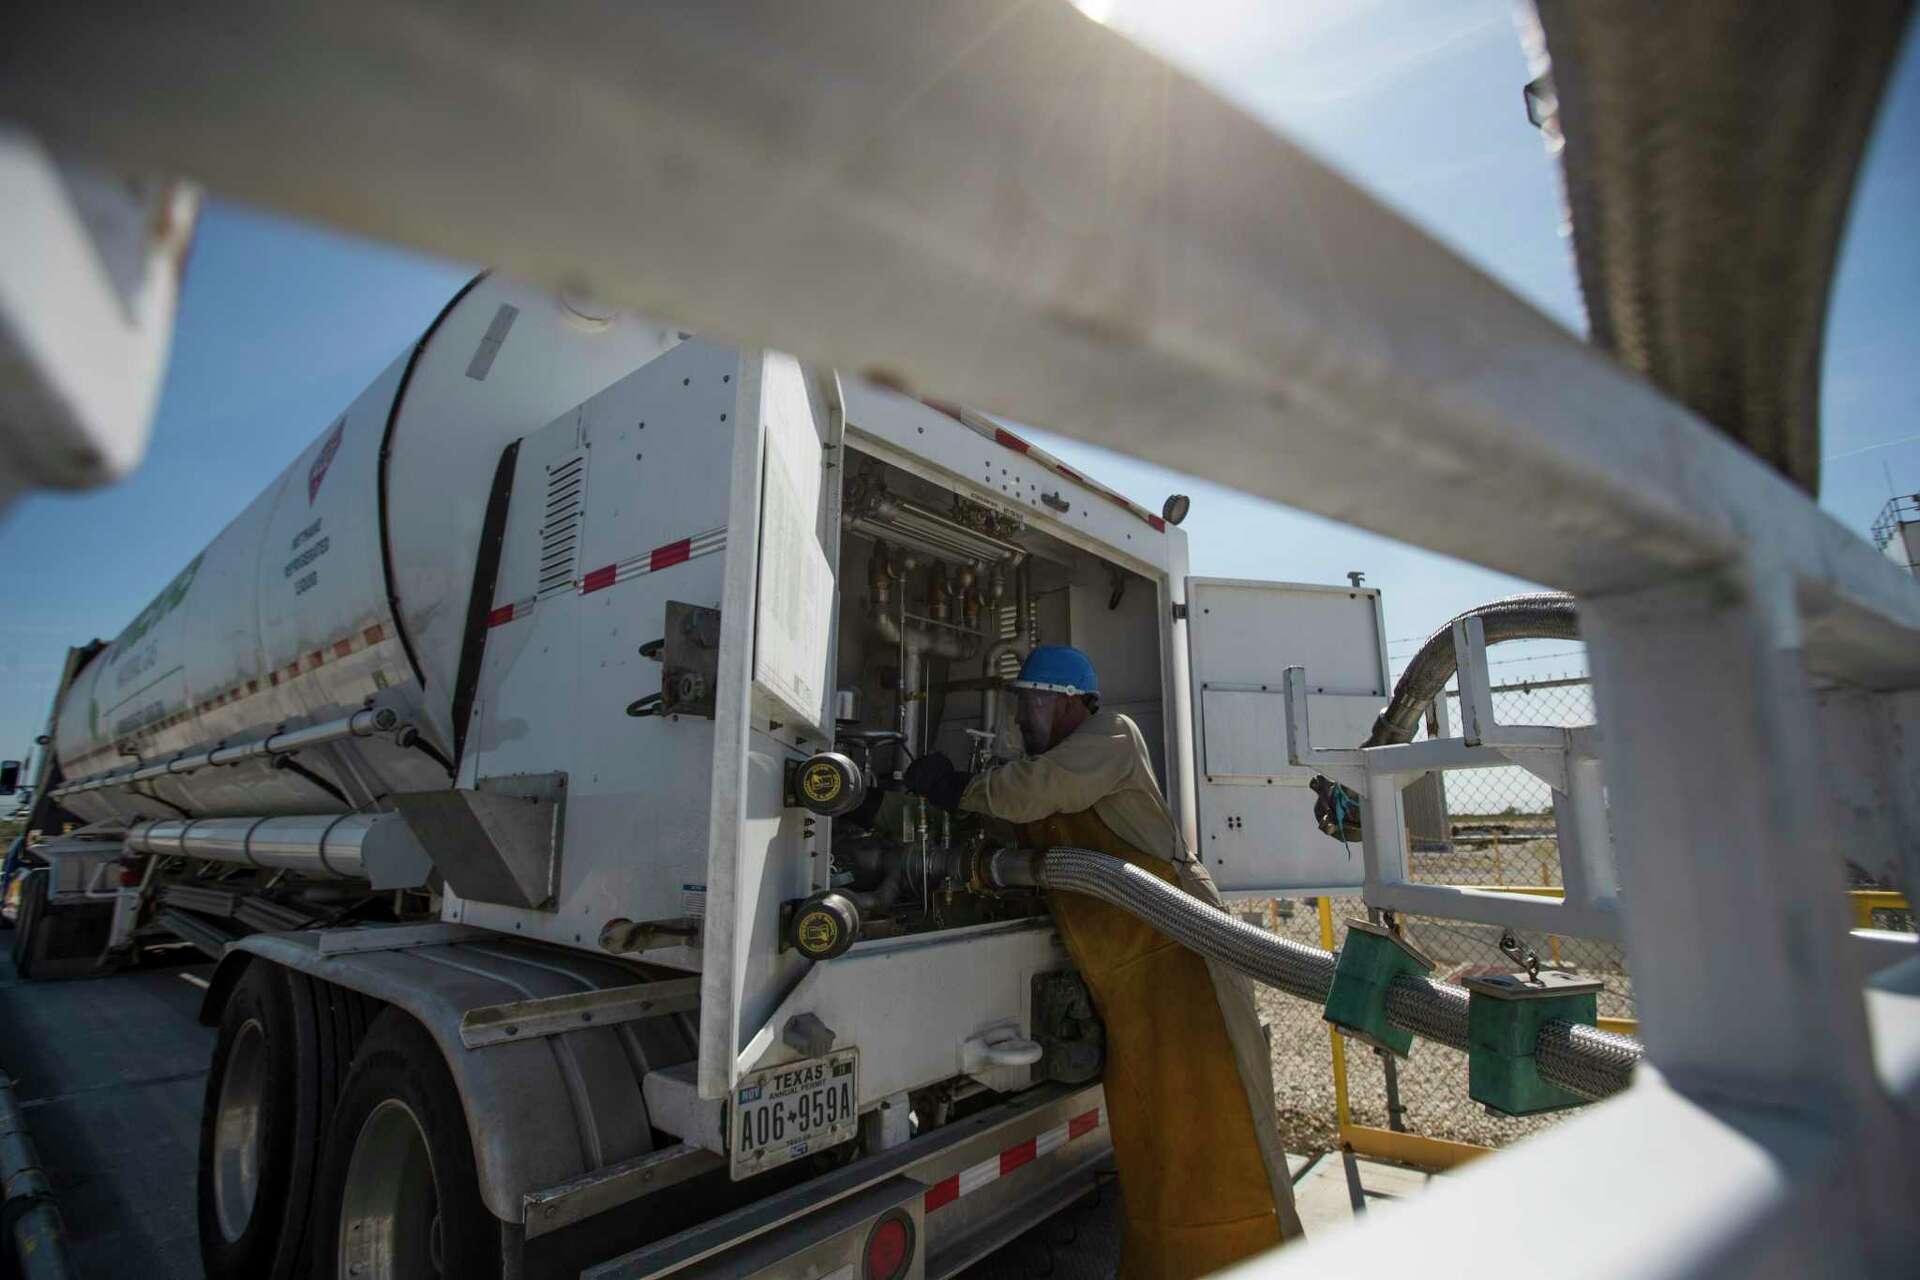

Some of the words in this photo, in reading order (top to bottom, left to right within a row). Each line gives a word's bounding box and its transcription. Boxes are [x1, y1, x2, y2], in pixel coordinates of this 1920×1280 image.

[774, 1064, 823, 1090] TEXAS
[741, 1101, 784, 1152] A06
[799, 1082, 850, 1132] 959A
